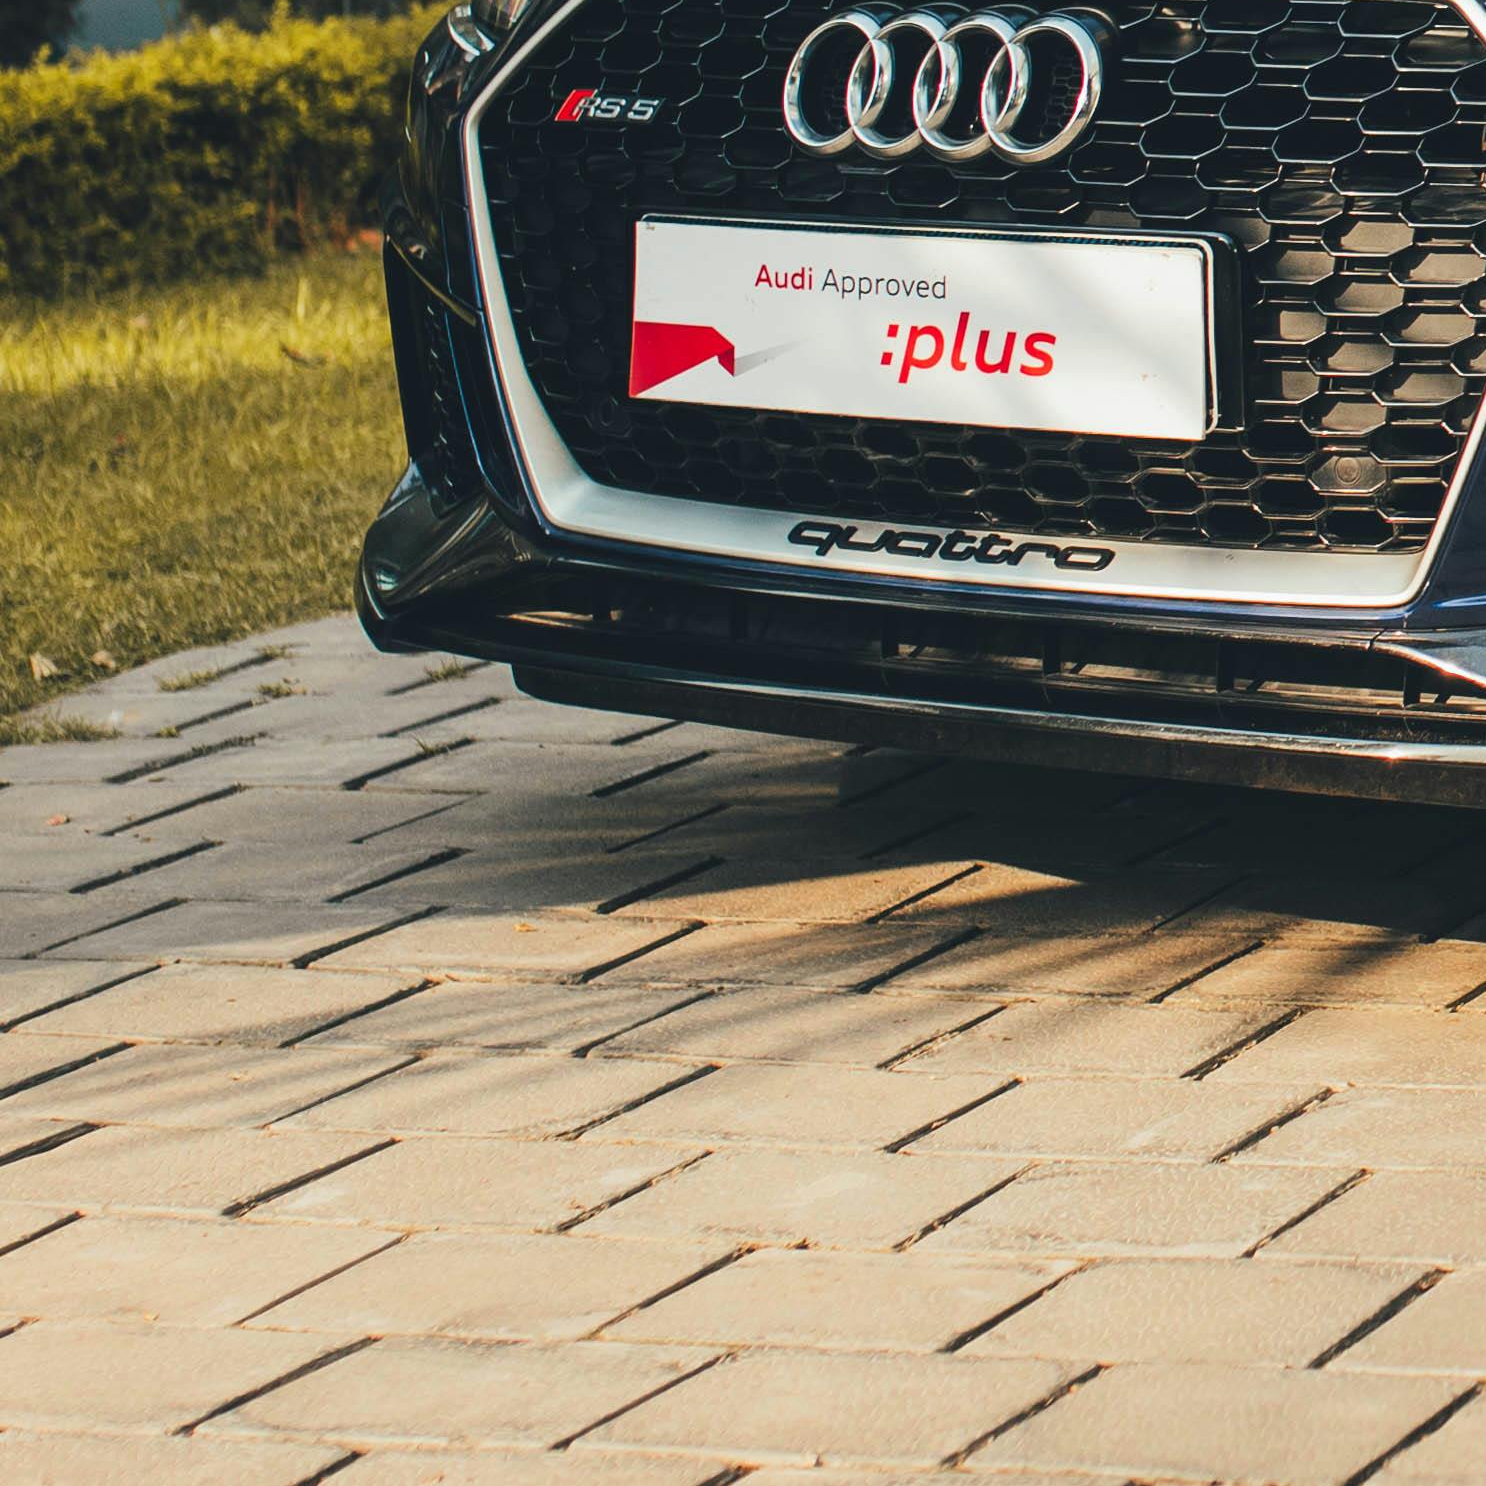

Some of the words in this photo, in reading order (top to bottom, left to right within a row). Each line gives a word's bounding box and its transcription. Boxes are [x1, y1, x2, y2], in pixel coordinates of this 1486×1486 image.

[754, 264, 813, 291] Audi
[822, 268, 947, 300] Approved
[788, 521, 1116, 572] quattro
